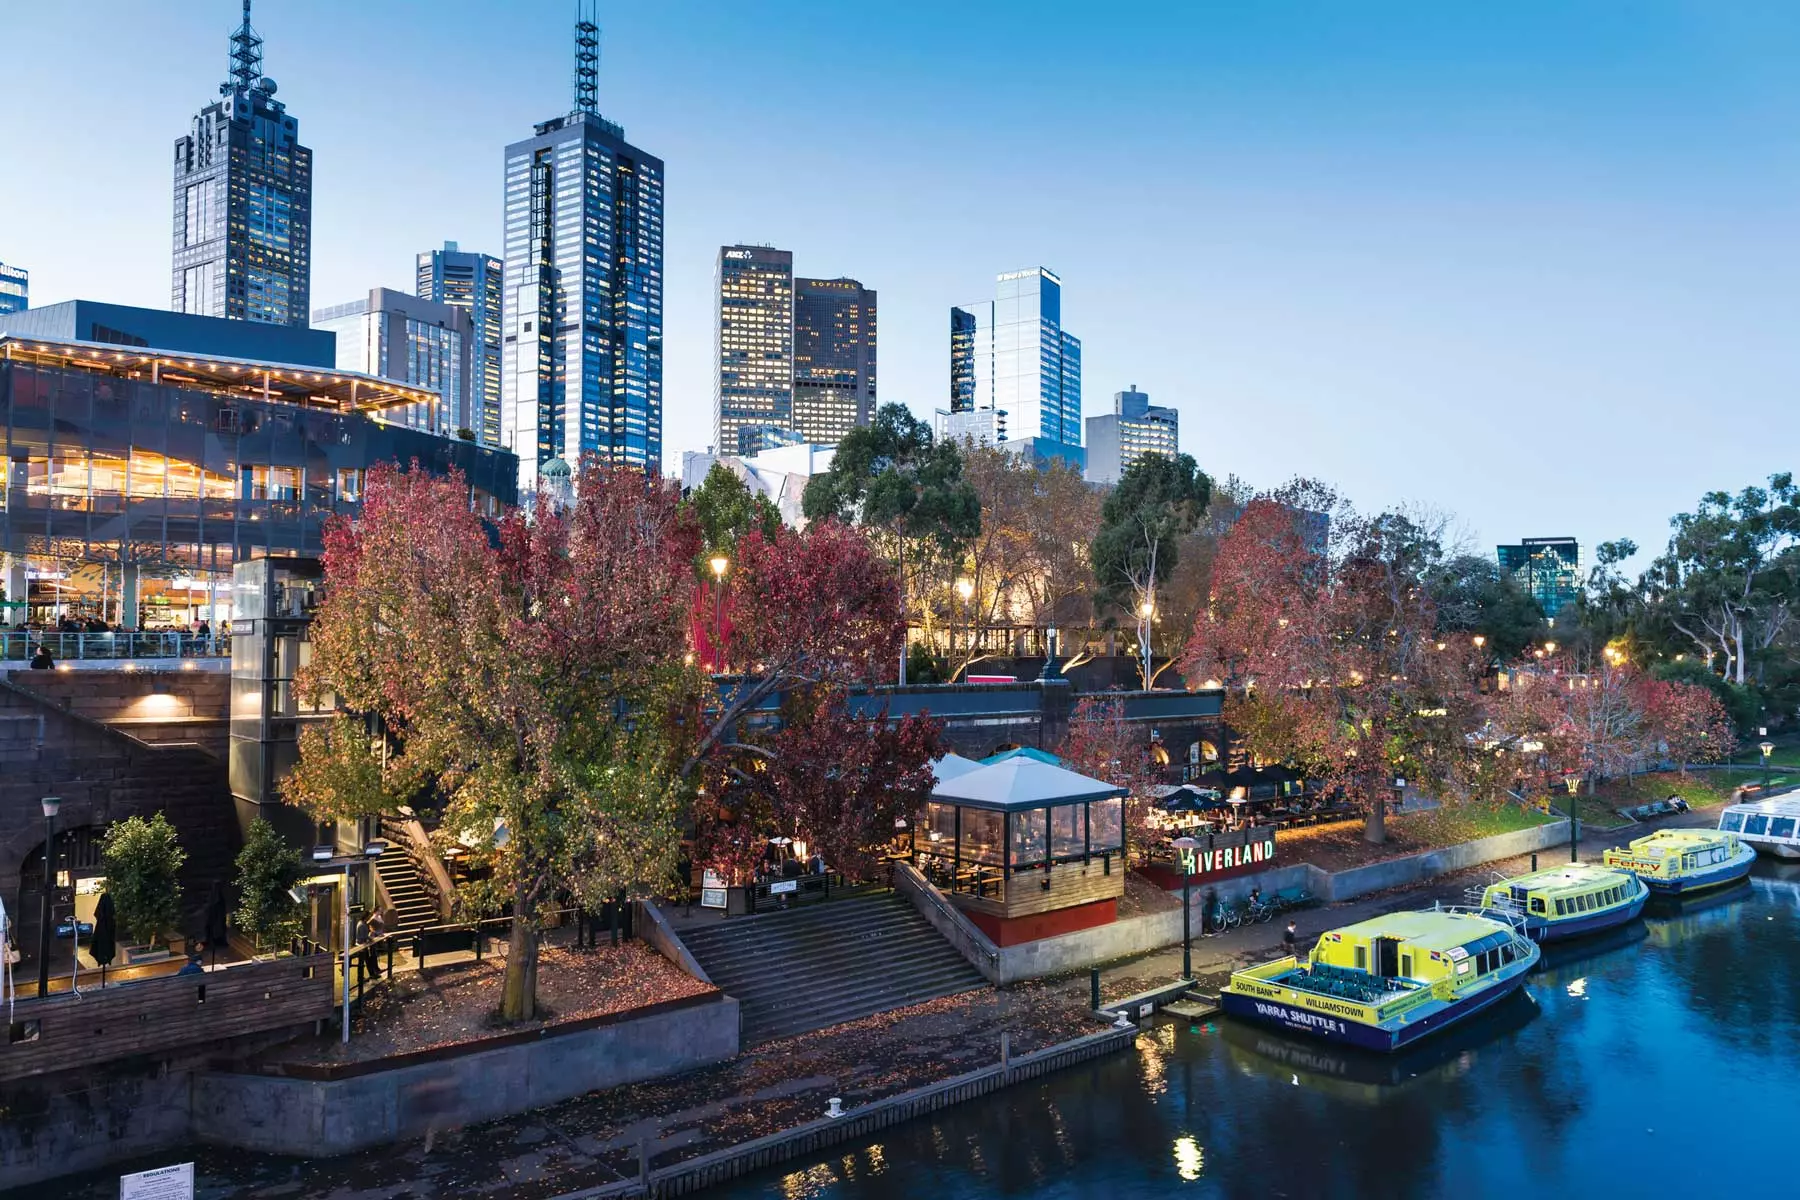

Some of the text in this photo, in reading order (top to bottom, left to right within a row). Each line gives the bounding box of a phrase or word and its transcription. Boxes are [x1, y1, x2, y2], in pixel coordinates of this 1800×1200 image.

[811, 281, 857, 290] SOFITEL
[1187, 840, 1273, 875] RIVERLAND
[1609, 857, 1660, 871] Ferry
[1236, 981, 1274, 998] SOUTH BANK
[1305, 997, 1364, 1018] WILLIAMSTOWN
[1254, 1002, 1346, 1034] YARRA SHUTTLE 1
